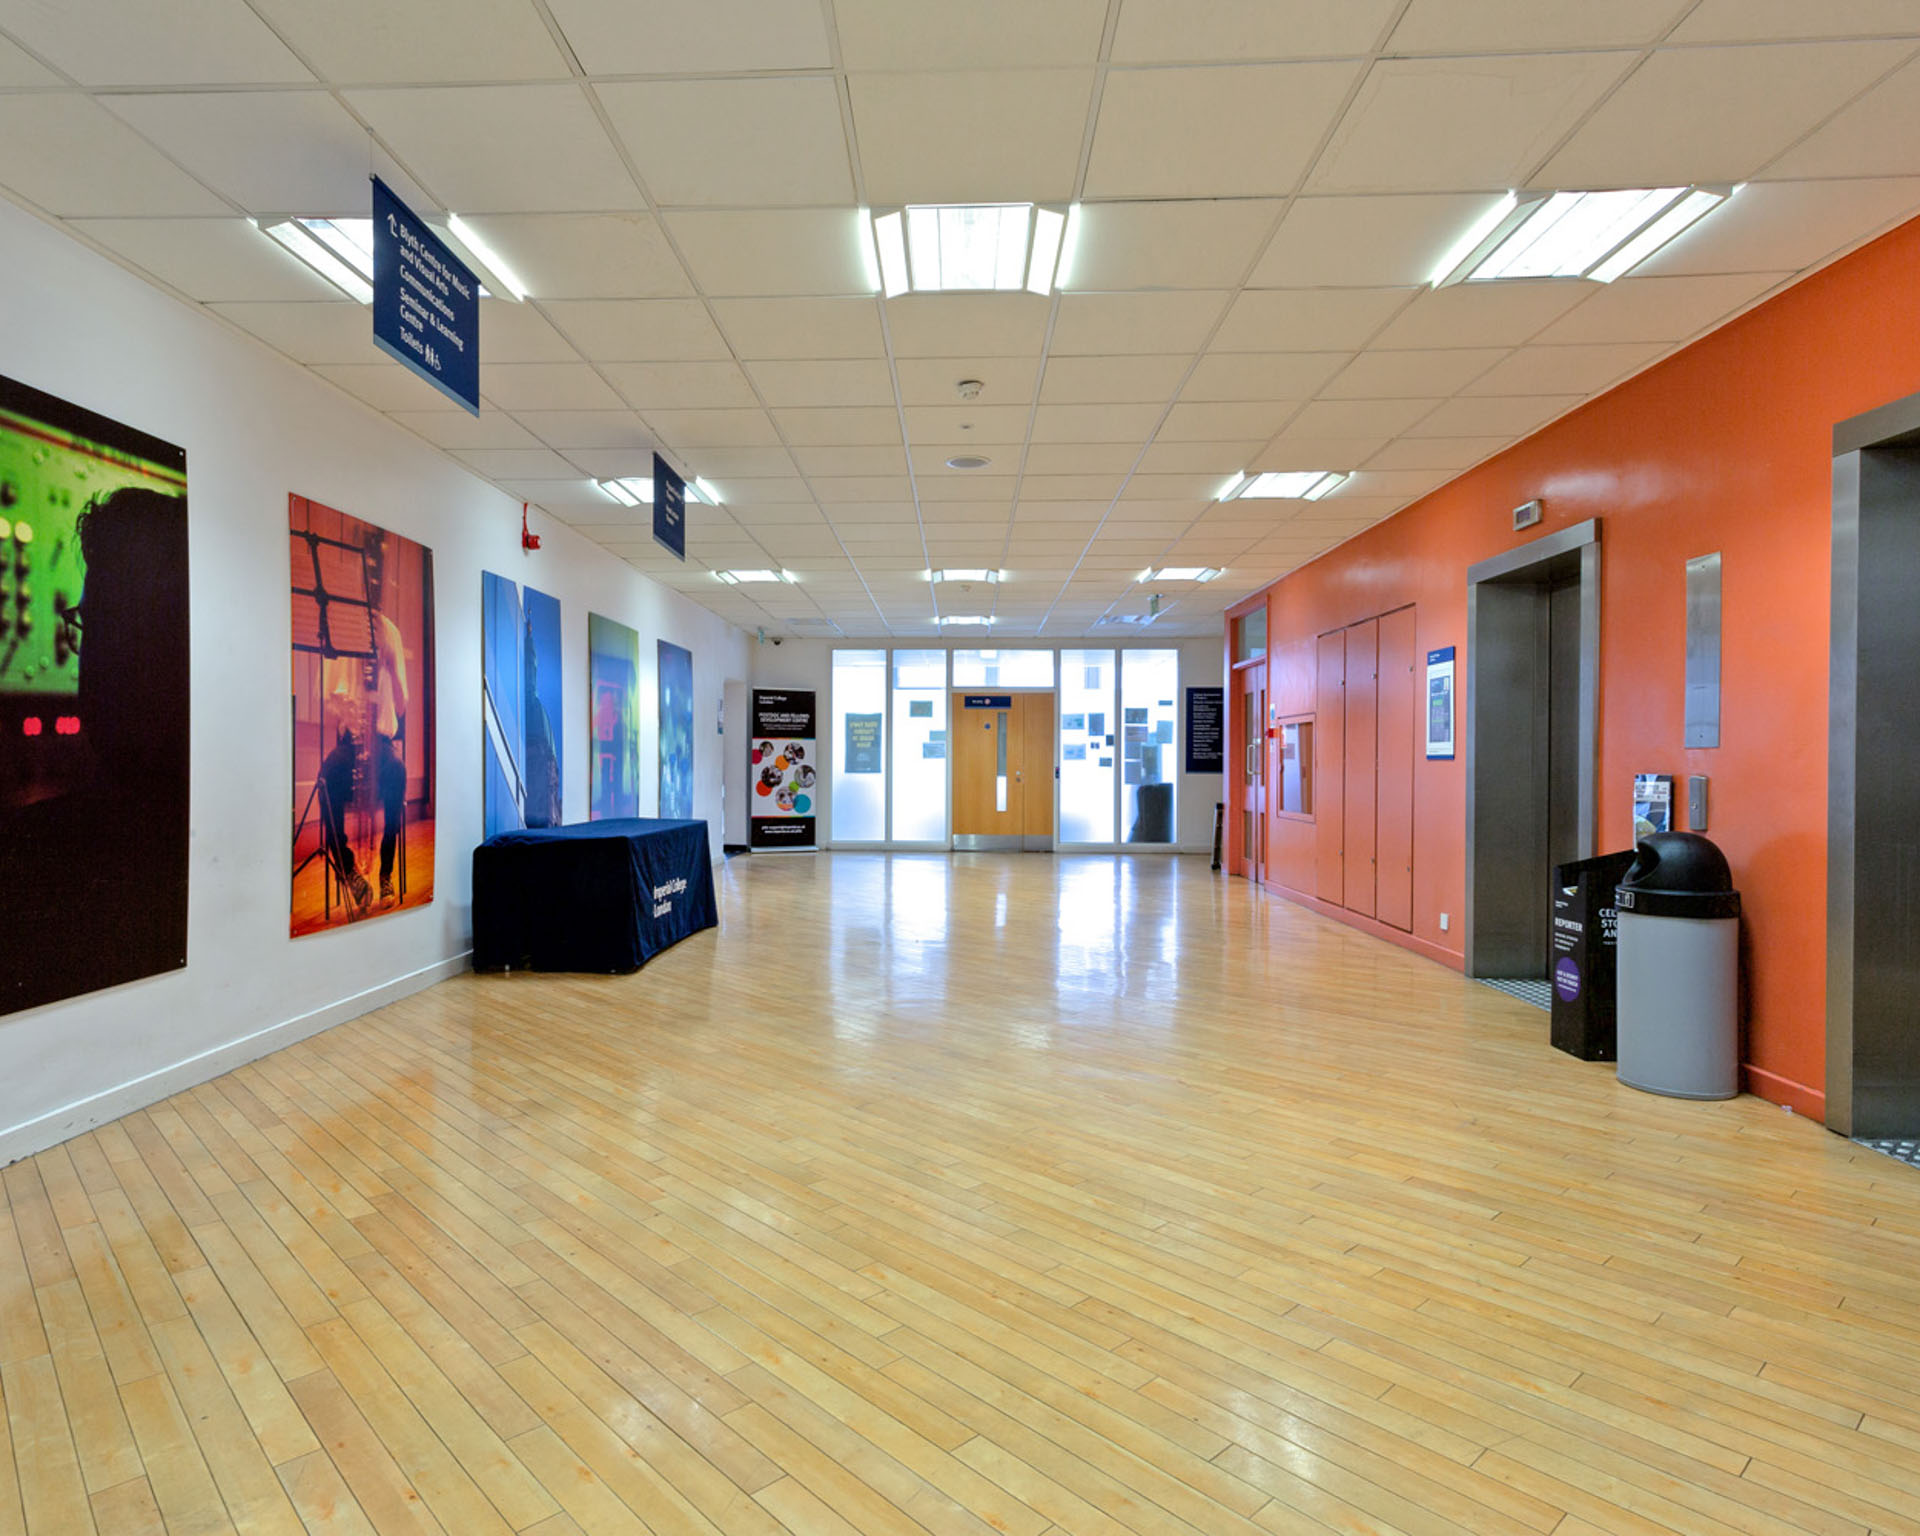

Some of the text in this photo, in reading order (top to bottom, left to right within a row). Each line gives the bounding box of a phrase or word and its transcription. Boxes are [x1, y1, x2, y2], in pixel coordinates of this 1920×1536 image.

[400, 223, 471, 301] Blyth Centre for Music
[400, 245, 450, 297] and Visual Arts
[400, 264, 455, 322] Communications
[400, 304, 424, 333] Centre
[400, 287, 429, 321] Seminar
[437, 317, 464, 353] Learning
[400, 325, 424, 355] Toilets
[1555, 917, 1583, 932] REPORTER
